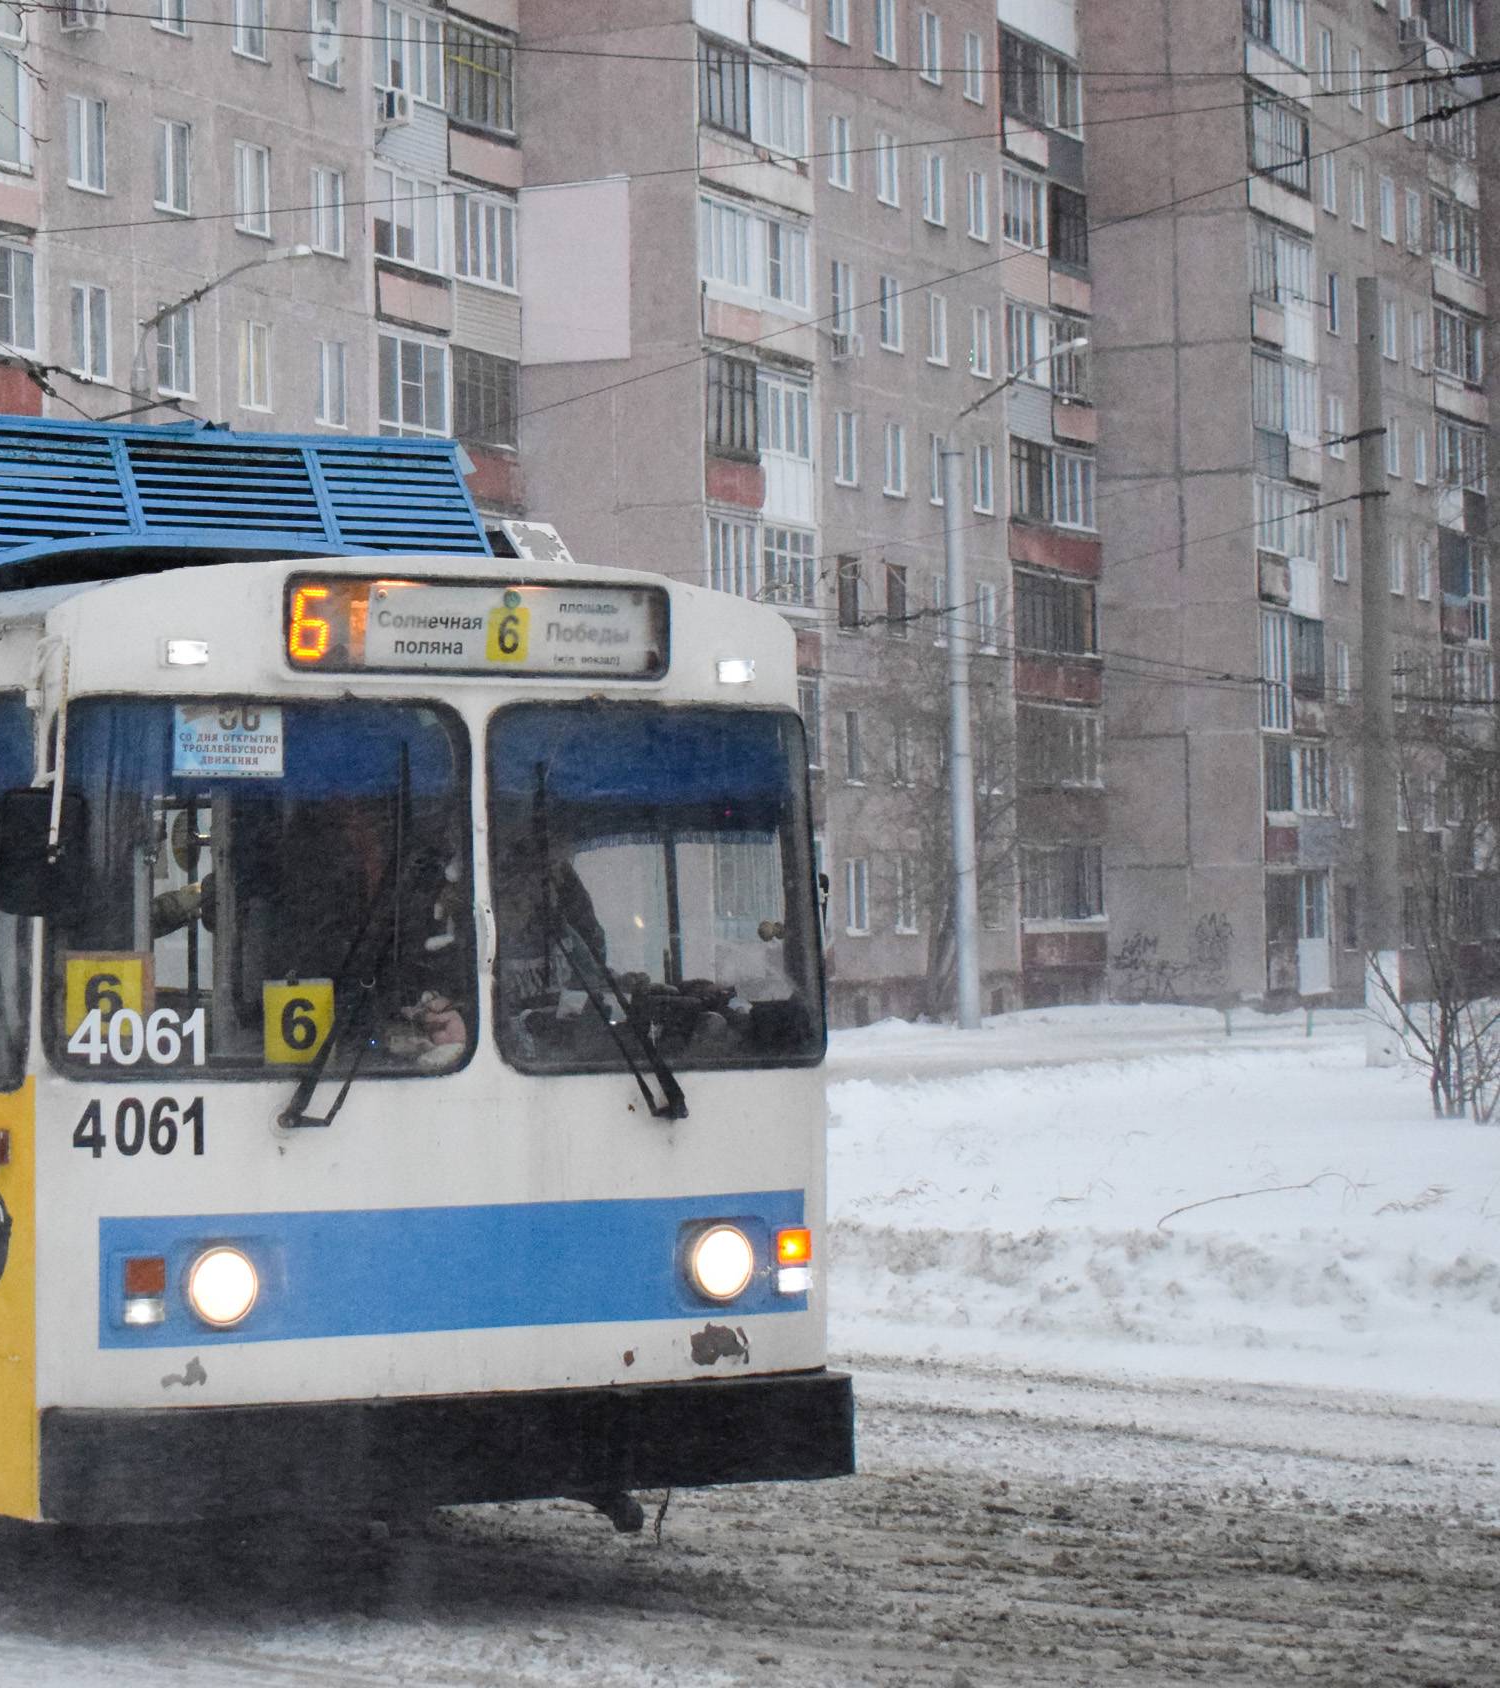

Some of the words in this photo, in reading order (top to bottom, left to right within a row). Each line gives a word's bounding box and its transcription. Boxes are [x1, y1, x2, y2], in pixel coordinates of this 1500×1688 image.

[290, 587, 329, 660] 6
[377, 610, 483, 630] Солнечная
[498, 614, 520, 654] 6
[546, 622, 630, 646] Победы
[394, 639, 463, 655] поляна
[179, 732, 193, 742] СО
[196, 732, 219, 743] ДНЯ
[222, 733, 279, 744] ОТКРЫТИЯ
[181, 743, 277, 755] ТРОЛЛЕЙБУСНОГО
[201, 756, 259, 767] ДВИЖЕНИЯ
[84, 973, 124, 1025] 6
[67, 1007, 206, 1066] 4061
[281, 997, 317, 1051] 6
[73, 1096, 205, 1159] 4061
